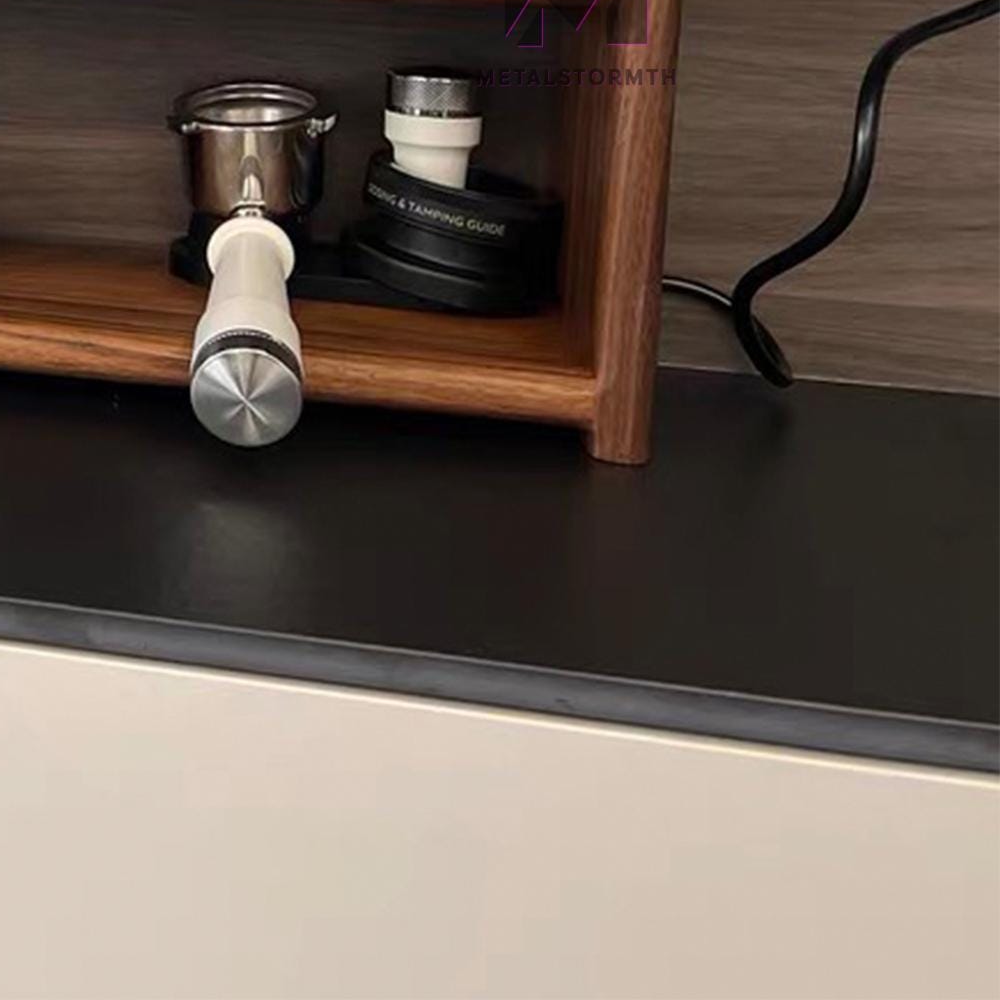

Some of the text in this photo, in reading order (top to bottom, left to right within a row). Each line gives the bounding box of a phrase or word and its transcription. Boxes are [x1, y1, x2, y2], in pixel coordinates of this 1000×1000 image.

[397, 197, 406, 210] &
[407, 200, 465, 228] TAMPING
[466, 218, 506, 237] GUIDE
